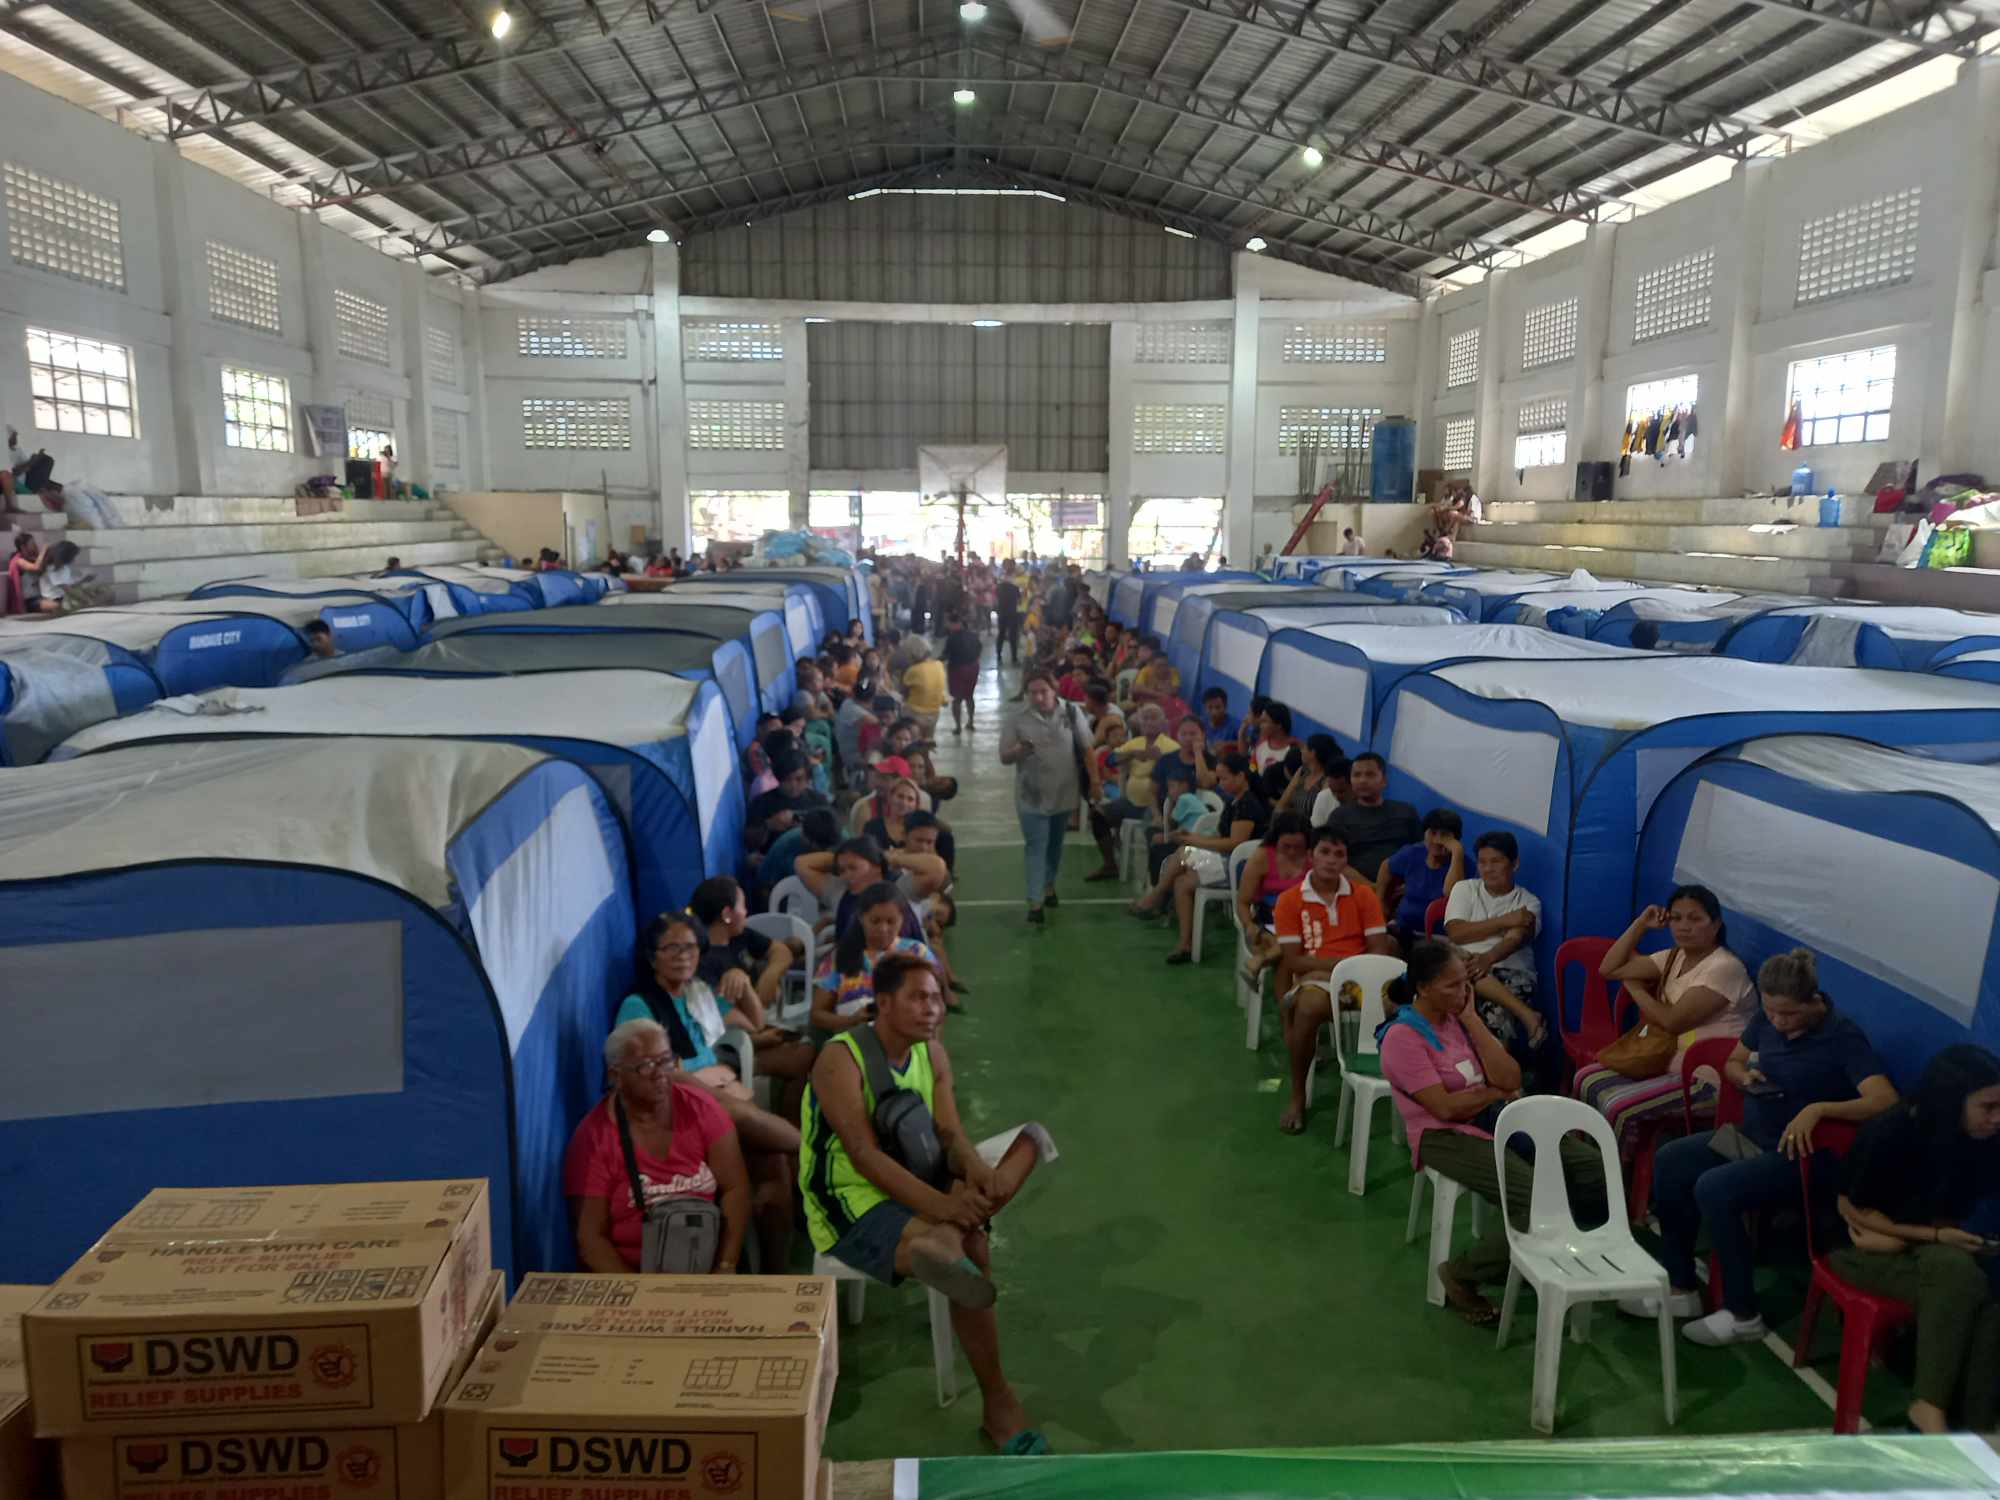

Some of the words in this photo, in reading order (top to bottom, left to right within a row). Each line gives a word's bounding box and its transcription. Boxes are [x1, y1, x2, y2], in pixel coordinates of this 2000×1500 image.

[150, 1243, 254, 1257] HANDLE
[261, 1241, 326, 1253] WITH
[332, 1238, 403, 1249] CARE
[183, 1263, 227, 1275] NOT
[232, 1261, 281, 1272] FOR
[284, 1259, 339, 1271] SALE
[608, 1323, 665, 1333] WITH
[671, 1324, 766, 1333] HANDLE
[146, 1334, 299, 1376] DSWD
[90, 1390, 175, 1409] RELIEF
[183, 1383, 303, 1405] SUPPLIES
[180, 1436, 330, 1475] DSWD
[549, 1437, 692, 1474] DSWD
